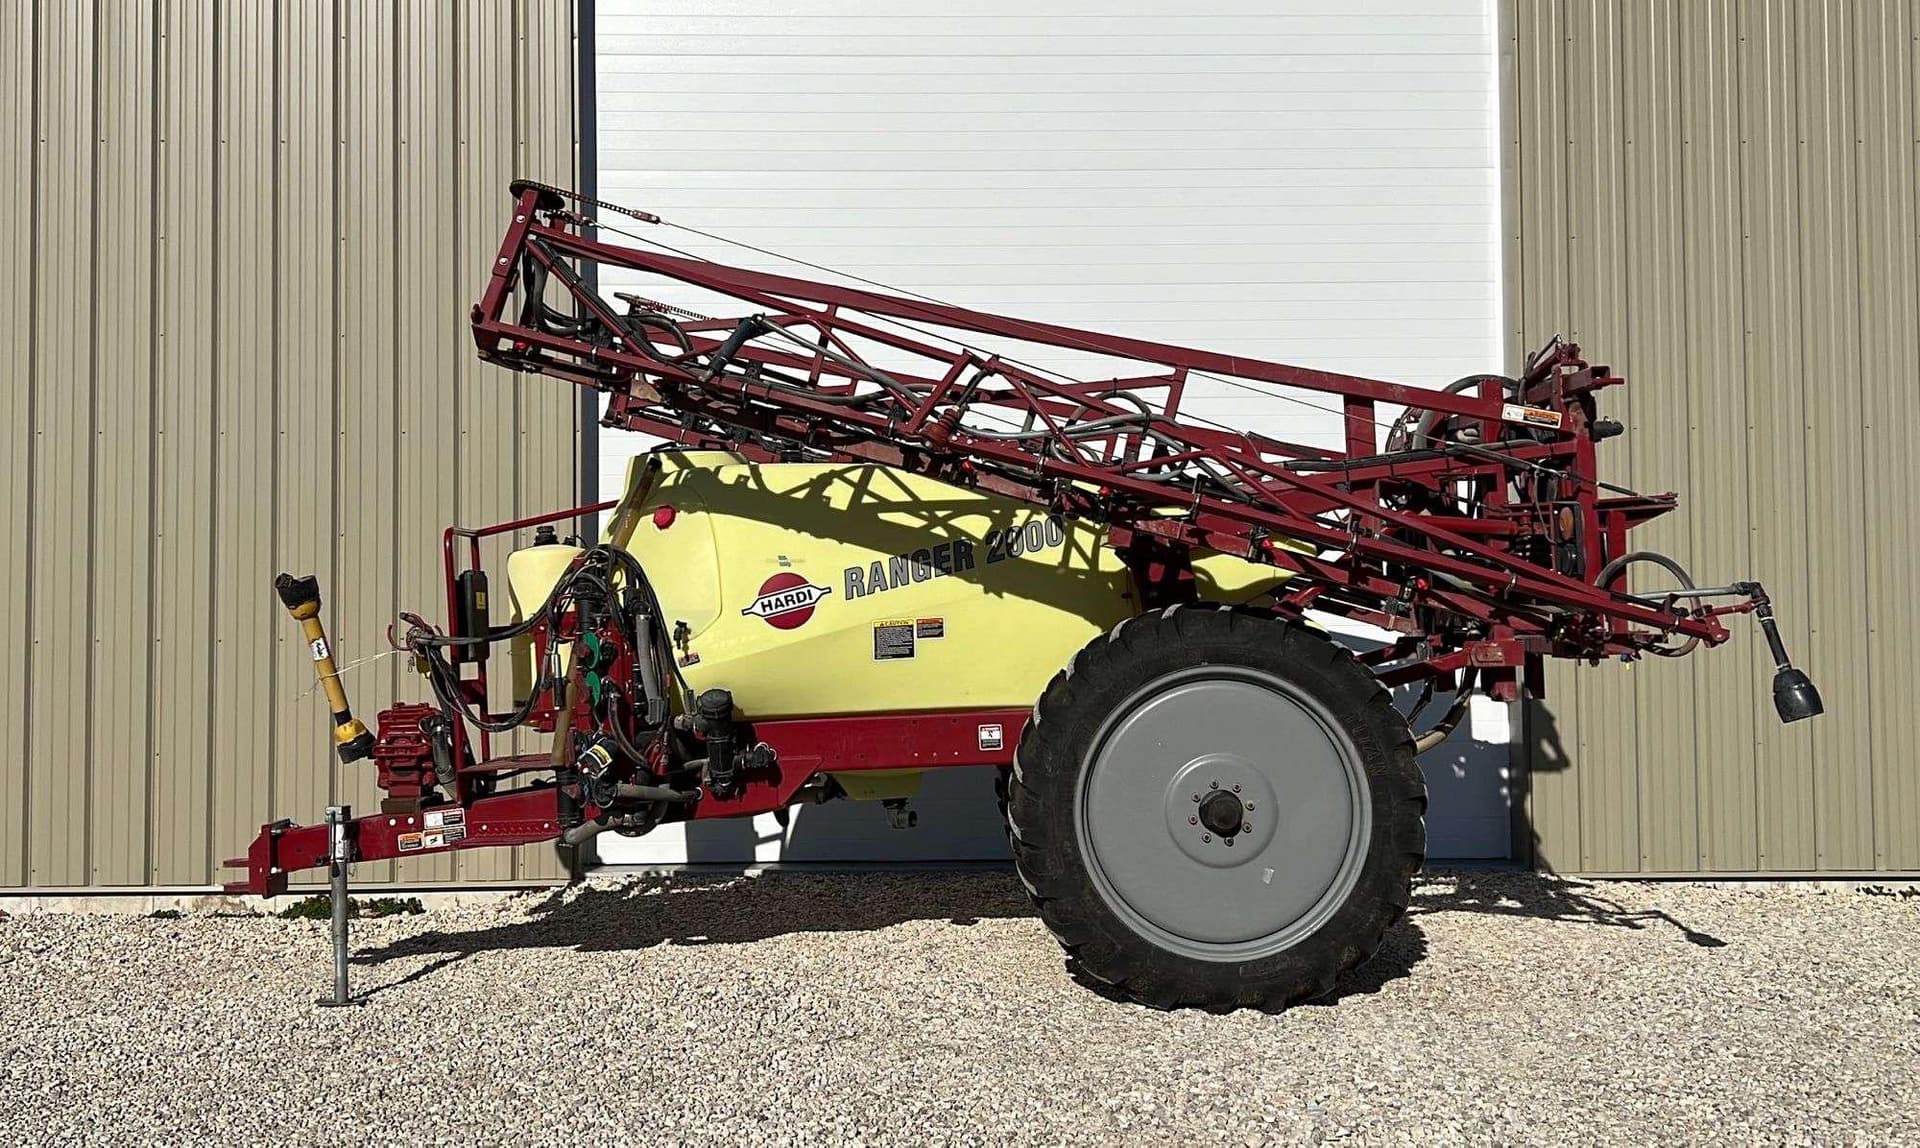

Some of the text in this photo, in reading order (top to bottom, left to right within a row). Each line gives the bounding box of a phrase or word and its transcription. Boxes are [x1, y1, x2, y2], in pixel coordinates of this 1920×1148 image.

[844, 515, 1065, 600] RANGER 2000
[761, 588, 813, 613] HARDI
